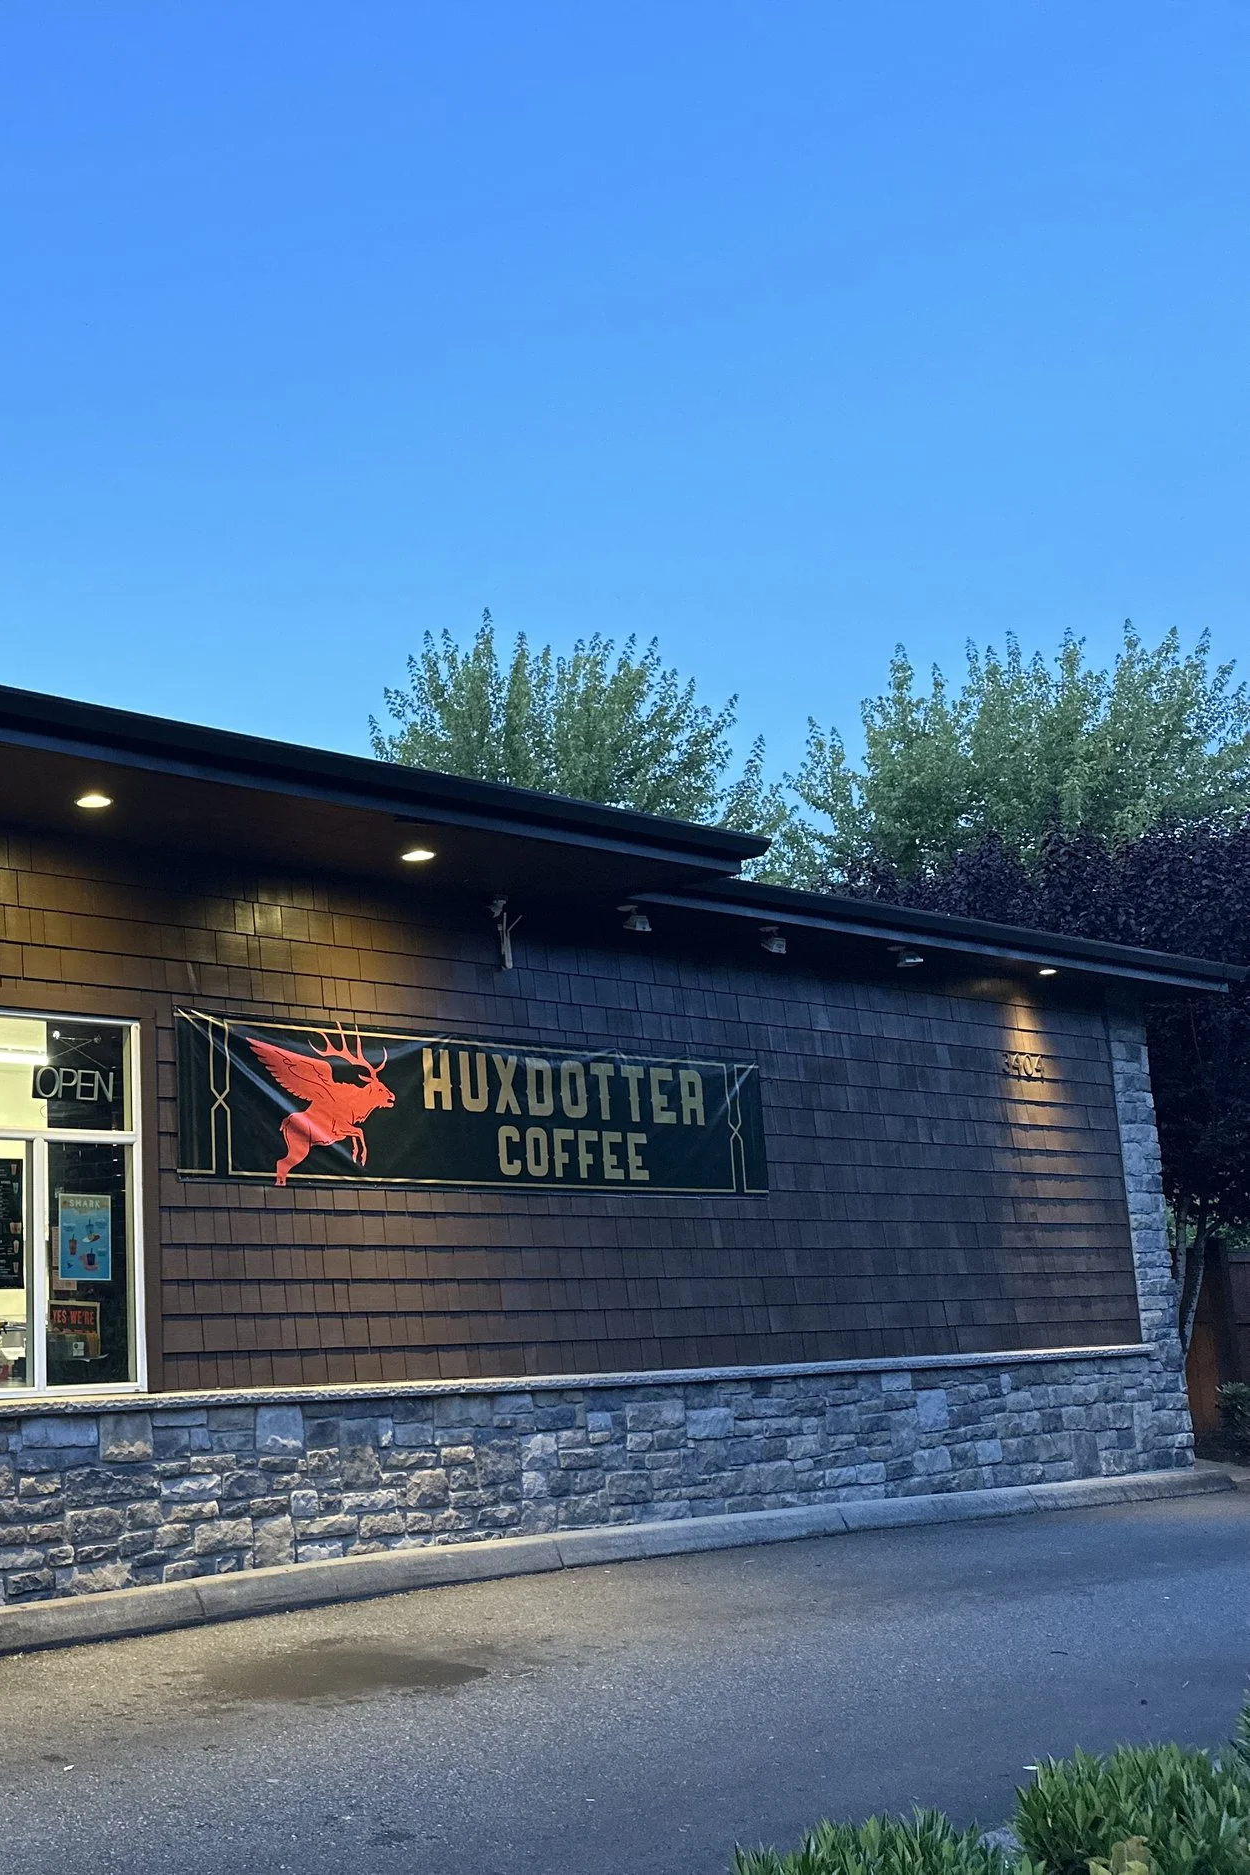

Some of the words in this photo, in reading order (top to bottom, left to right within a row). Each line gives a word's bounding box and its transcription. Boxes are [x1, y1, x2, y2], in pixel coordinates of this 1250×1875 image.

[36, 1066, 113, 1102] OPEN
[422, 1048, 706, 1126] HUXDOTTER
[498, 1126, 650, 1180] COFFEE
[69, 1200, 100, 1208] SHARK
[53, 1309, 67, 1324] YES
[70, 1310, 95, 1325] WE'RE
